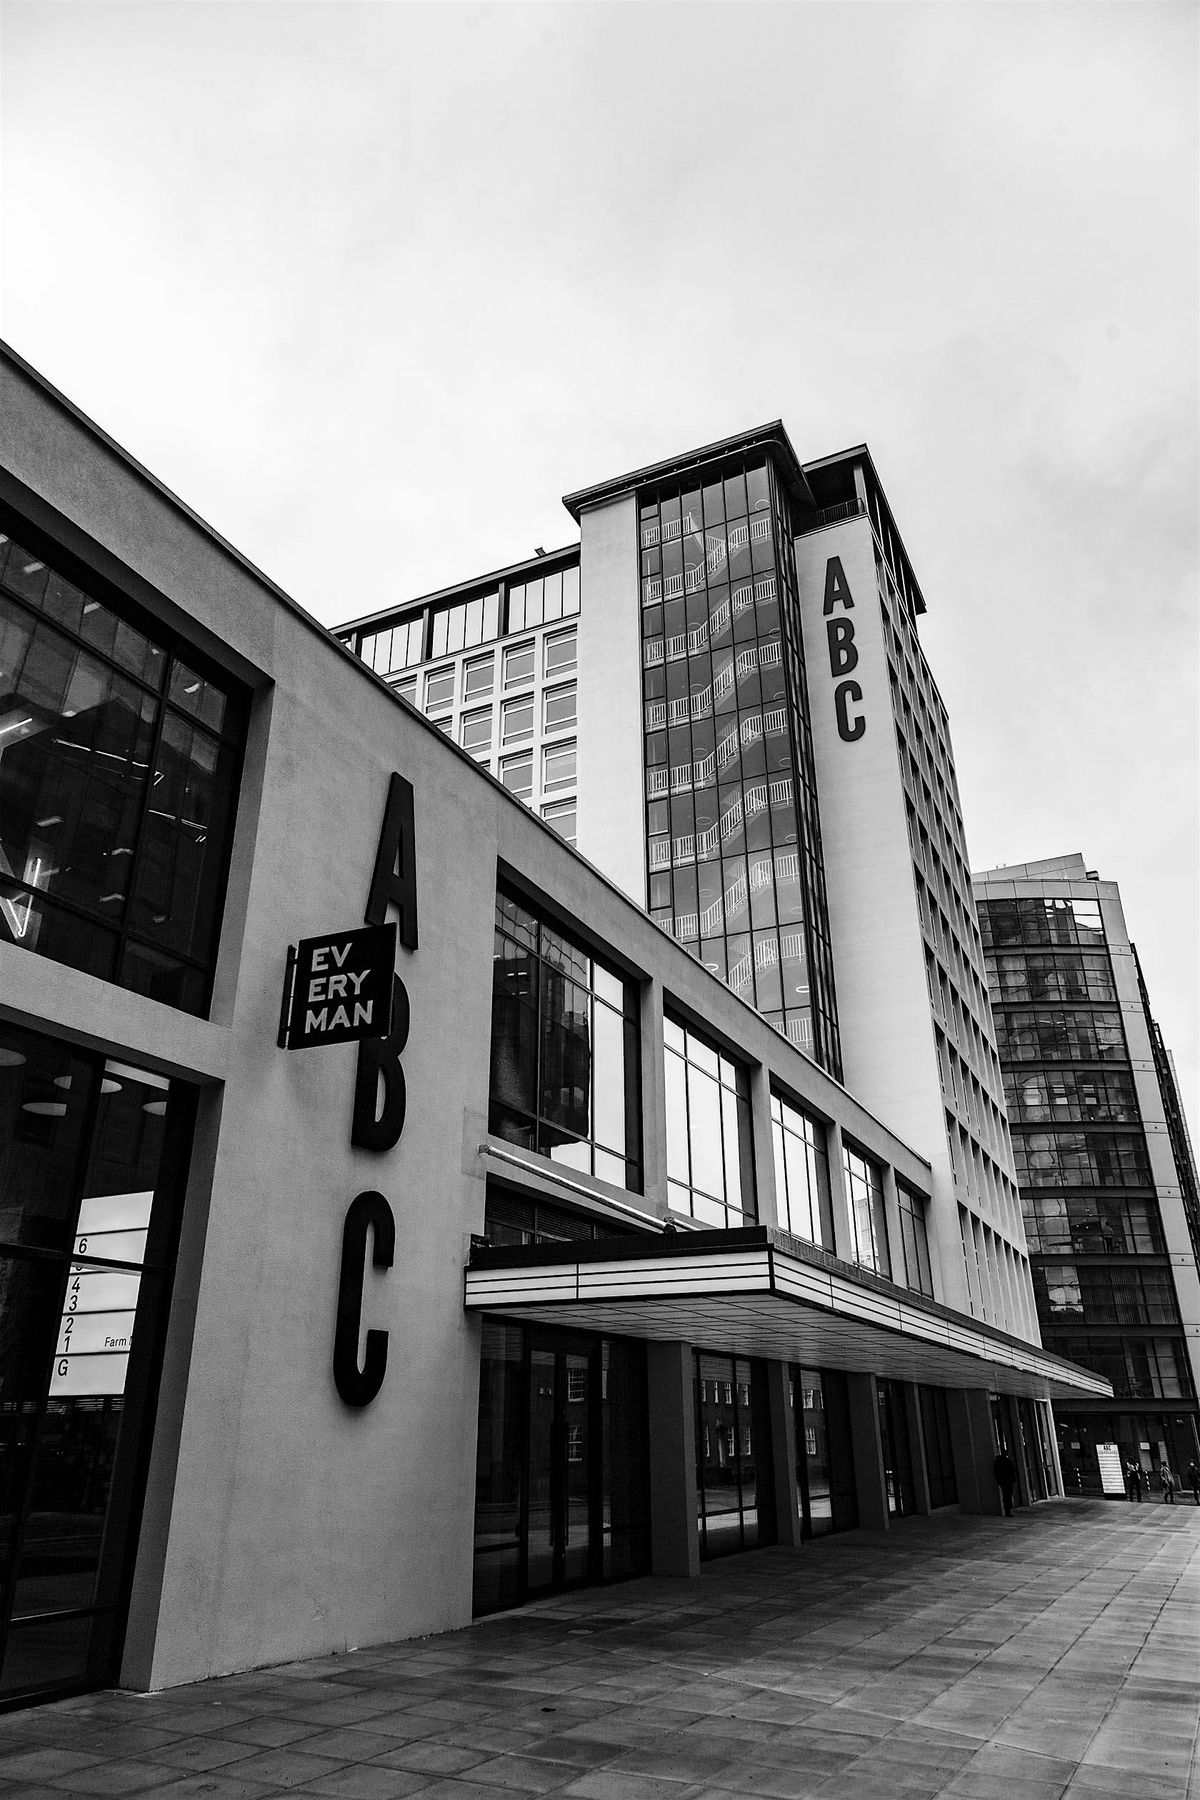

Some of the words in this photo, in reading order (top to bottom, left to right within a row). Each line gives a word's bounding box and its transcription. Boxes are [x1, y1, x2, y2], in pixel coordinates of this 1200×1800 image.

[823, 555, 866, 742] ABC
[311, 942, 353, 972] EV
[308, 969, 371, 1002] ERY
[304, 999, 373, 1034] MAN
[78, 1237, 88, 1254] 6
[71, 1276, 81, 1293] 4
[68, 1294, 78, 1312] 3
[64, 1317, 74, 1334] 2
[64, 1335, 71, 1352] 1
[104, 1335, 127, 1348] Farm
[57, 1358, 69, 1377] G
